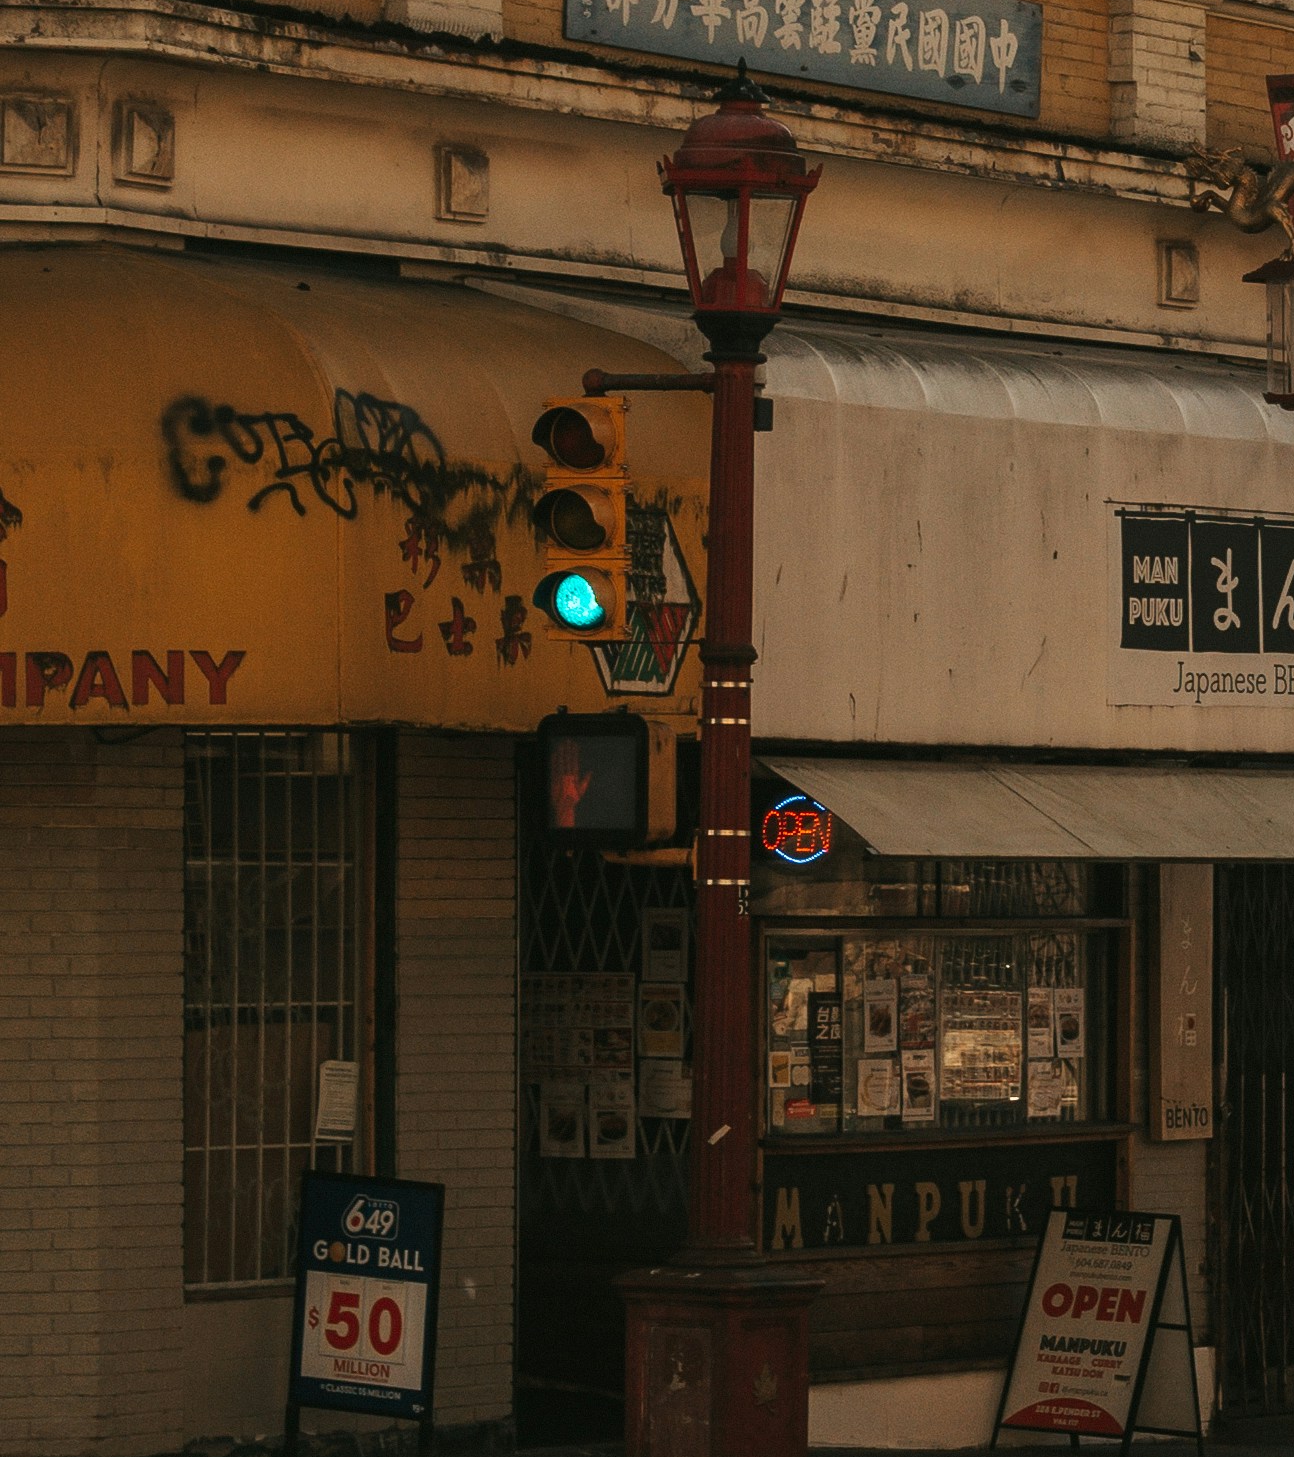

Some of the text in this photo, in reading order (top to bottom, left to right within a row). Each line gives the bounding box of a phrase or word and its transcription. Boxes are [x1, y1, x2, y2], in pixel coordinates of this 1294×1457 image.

[1132, 555, 1180, 585] MAN
[1128, 597, 1184, 628] PUKU
[0, 650, 247, 710] PANY
[1173, 661, 1267, 703] Japanese
[762, 810, 831, 853] OPEN
[1165, 1106, 1210, 1129] BENTO
[345, 1199, 395, 1236] 649
[377, 1245, 425, 1272] BALL
[1061, 1241, 1150, 1258] Japanese BENTO
[1041, 1283, 1147, 1324] OPEN
[1039, 1334, 1127, 1357] MANPUKU
[333, 1358, 391, 1378] MILLION
[367, 1388, 402, 1400] MILLION
